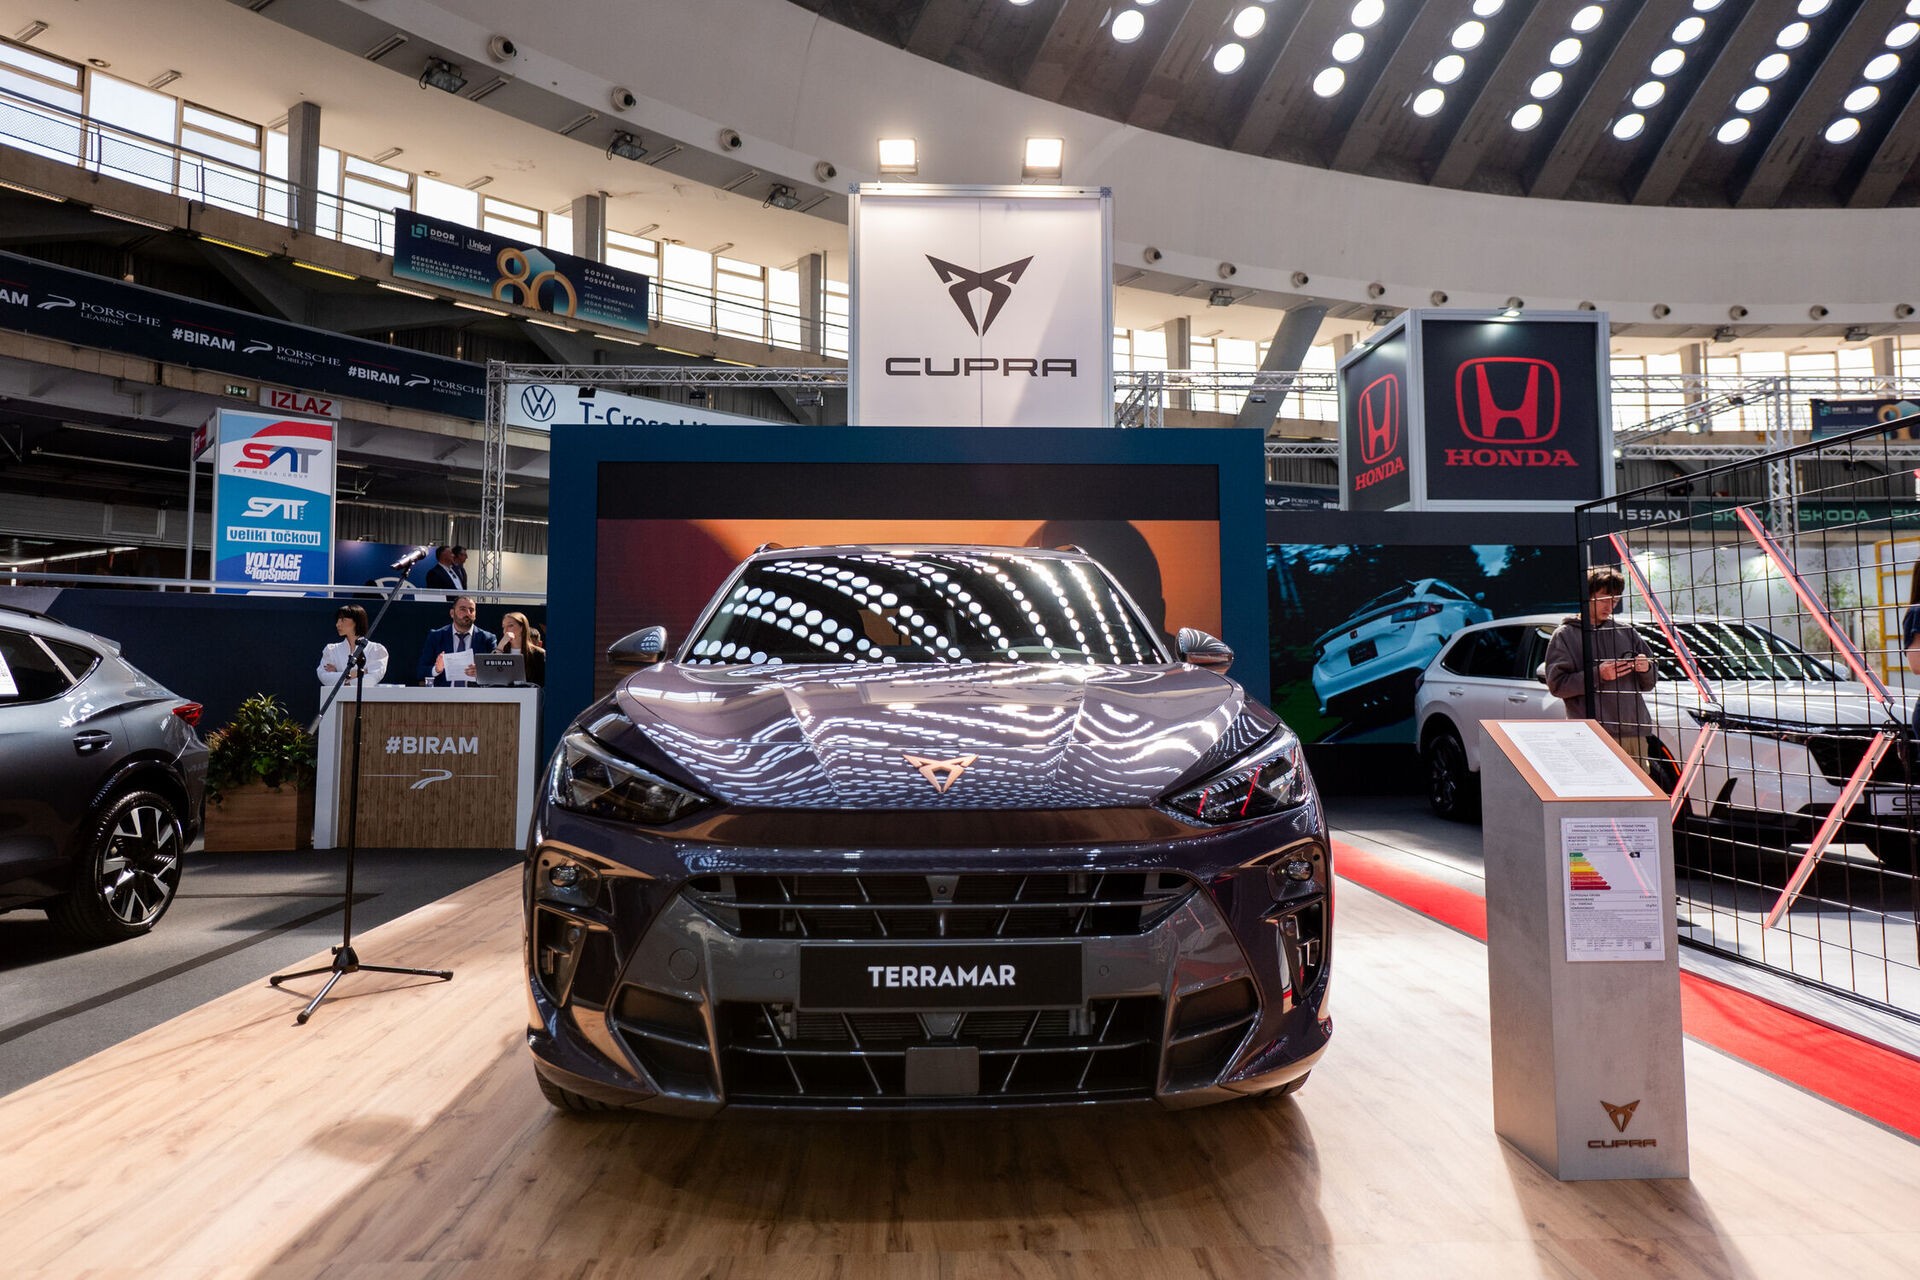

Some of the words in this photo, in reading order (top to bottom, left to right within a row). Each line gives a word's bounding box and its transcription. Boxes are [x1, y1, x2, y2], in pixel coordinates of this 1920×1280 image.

[430, 228, 455, 241] DDOR
[468, 239, 492, 253] Unipol
[411, 254, 450, 268] GENERALNI
[411, 265, 455, 280] AUTOMOBILA
[584, 268, 615, 280] GODINA
[80, 311, 124, 326] LEASING
[81, 301, 161, 327] PORSCHE
[172, 328, 236, 351] #BIRAM
[276, 346, 341, 367] PORSCHE
[276, 354, 314, 367] MOBILITY
[348, 366, 400, 386] #BIRAM
[885, 357, 1078, 378] CUPRA
[432, 387, 462, 397] PARTNER
[433, 378, 487, 396] PORSCHE
[271, 390, 332, 416] IZLAZ
[234, 443, 323, 474] SAT
[1444, 449, 1579, 467] HONDA
[252, 469, 278, 478] MEDIA
[1354, 456, 1406, 491] HONDA
[1619, 508, 1681, 521] ISSAN
[229, 529, 267, 541] veliki
[271, 530, 319, 545] točkovi
[245, 552, 303, 569] VOLTAGE
[385, 736, 479, 755] #BIRAM
[867, 964, 1016, 988] TERRAMAR
[1587, 1139, 1657, 1149] CUPRA
